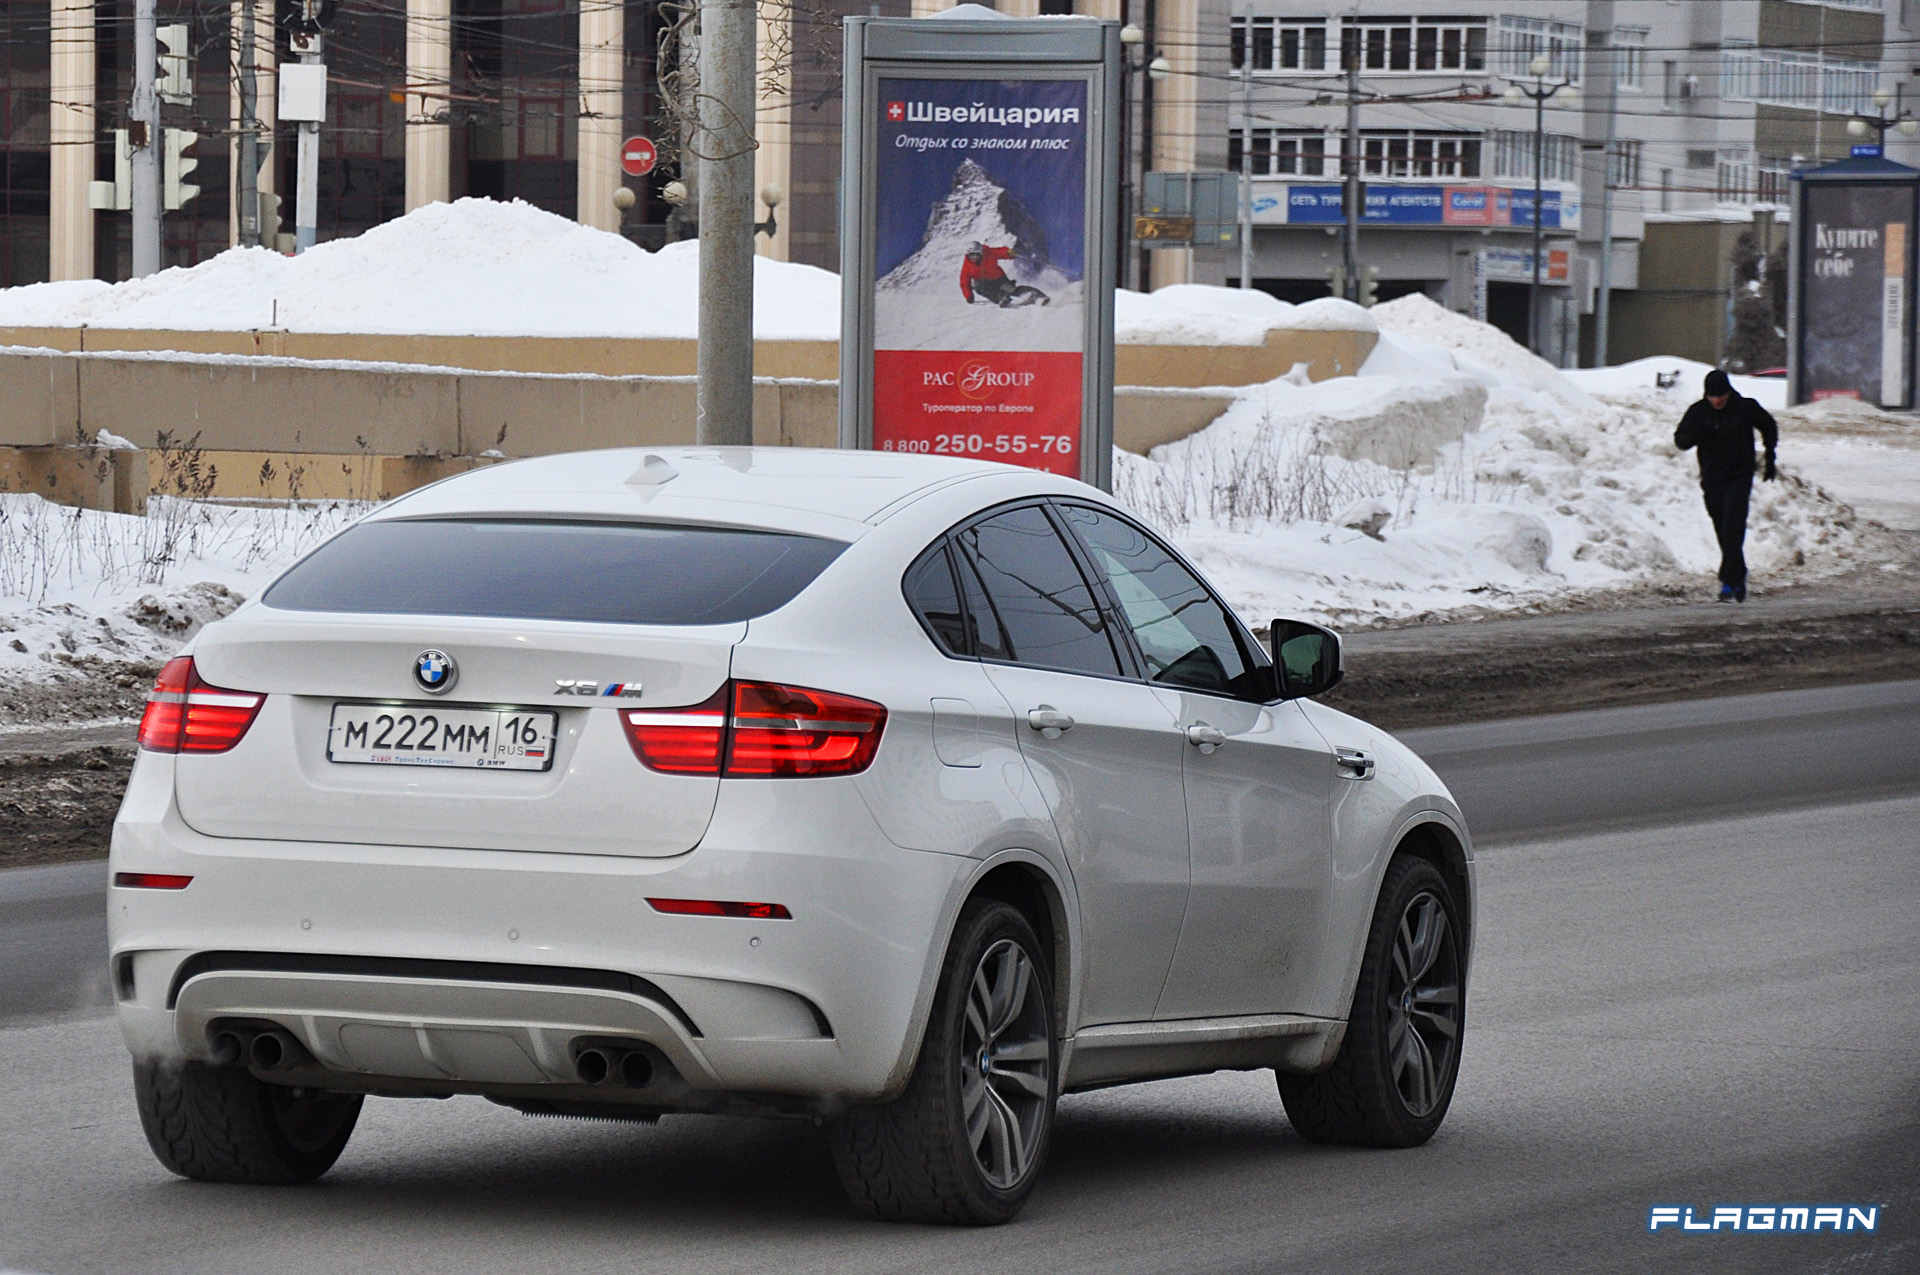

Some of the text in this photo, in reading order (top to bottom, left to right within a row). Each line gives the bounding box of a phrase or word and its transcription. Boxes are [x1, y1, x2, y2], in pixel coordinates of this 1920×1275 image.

[907, 101, 1079, 128] Швейцария
[895, 134, 1070, 152] Отдых со знаком плюс
[1816, 223, 1878, 254] Купите
[923, 364, 1035, 391] PAC GROUP
[922, 403, 982, 413] Туроператор
[999, 404, 1034, 413] Европе
[883, 434, 1072, 454] 8 800 250-55-76
[553, 679, 598, 696] X6
[344, 714, 490, 753] М222ММ
[504, 717, 538, 745] 16
[497, 745, 524, 756] RUS
